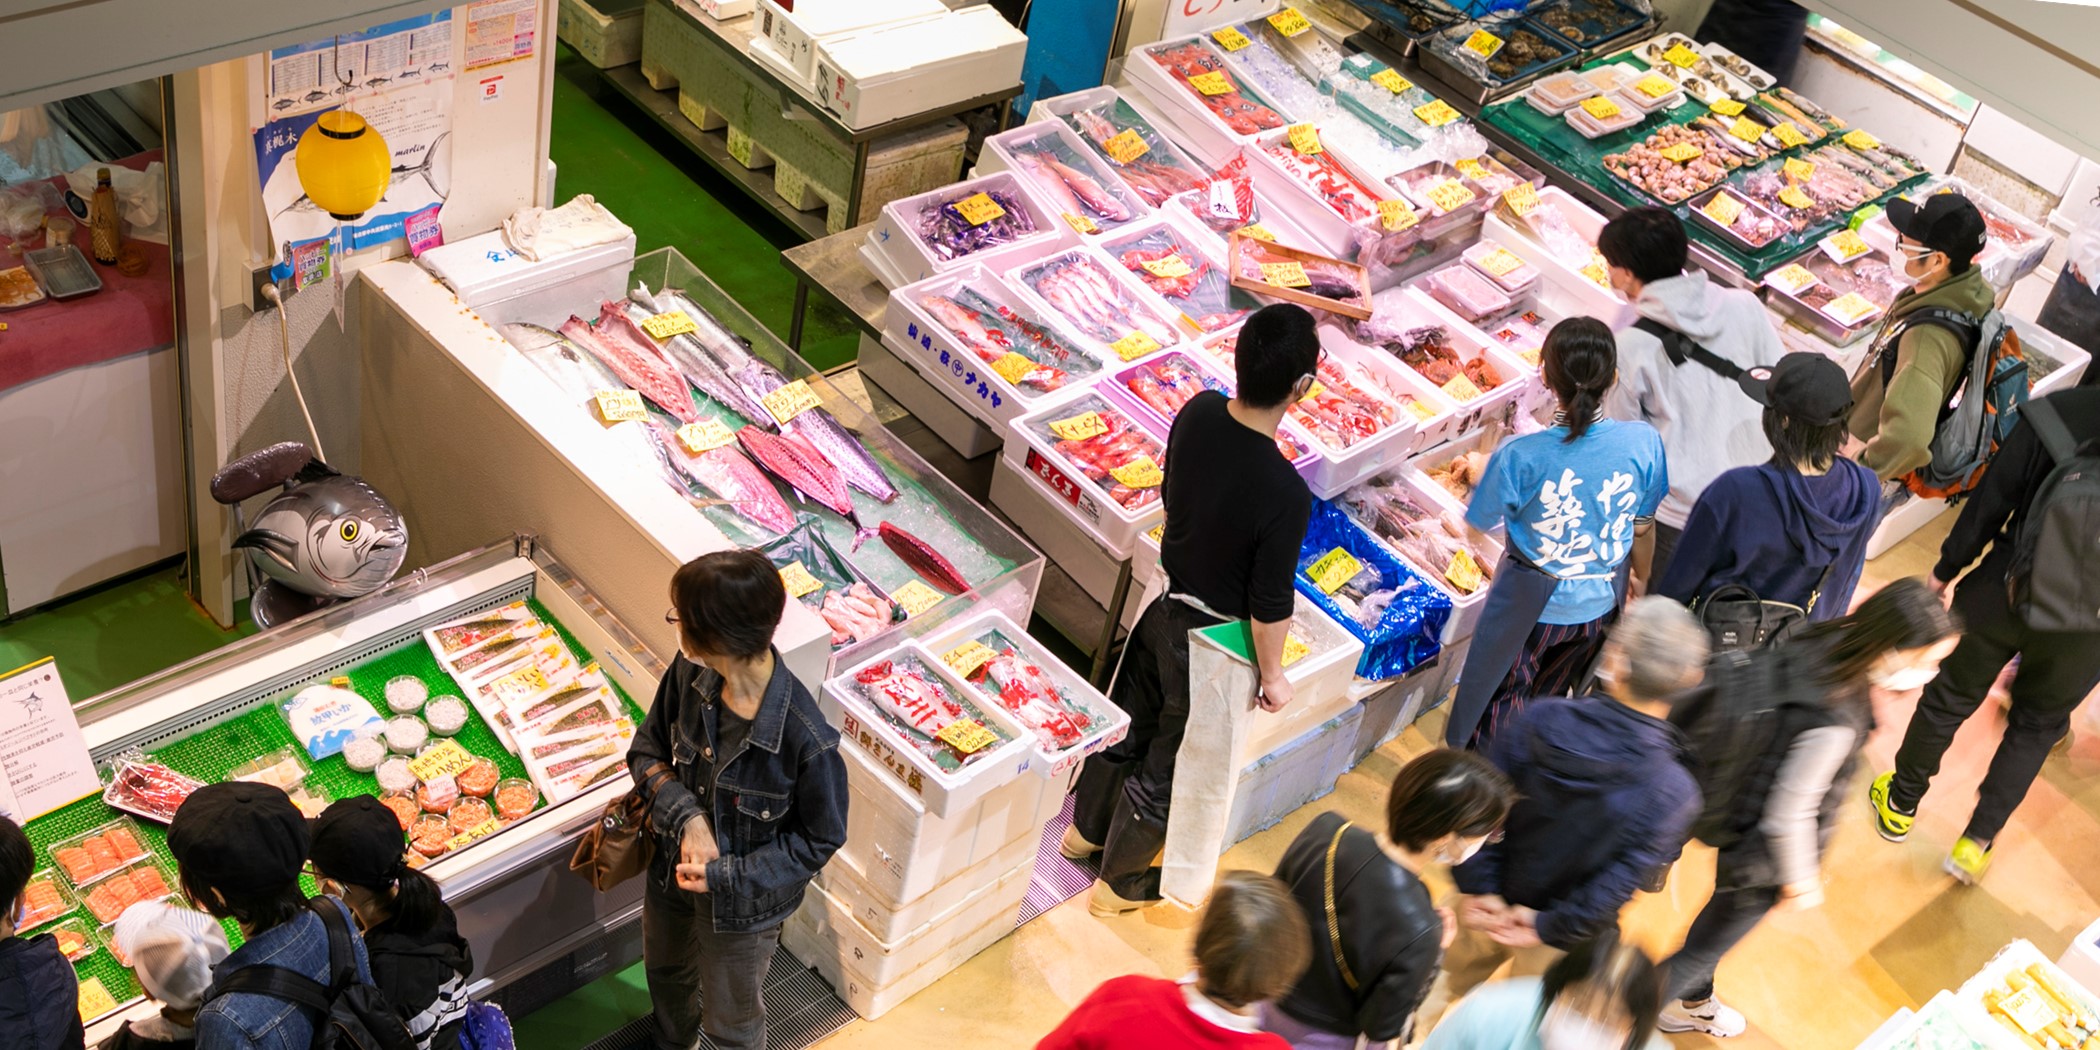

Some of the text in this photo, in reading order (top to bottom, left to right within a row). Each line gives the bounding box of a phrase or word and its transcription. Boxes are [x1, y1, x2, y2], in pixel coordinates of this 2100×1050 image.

[395, 143, 425, 157] marlin
[964, 371, 1002, 408] ナカヤ
[1597, 471, 1636, 566] やっぱり
